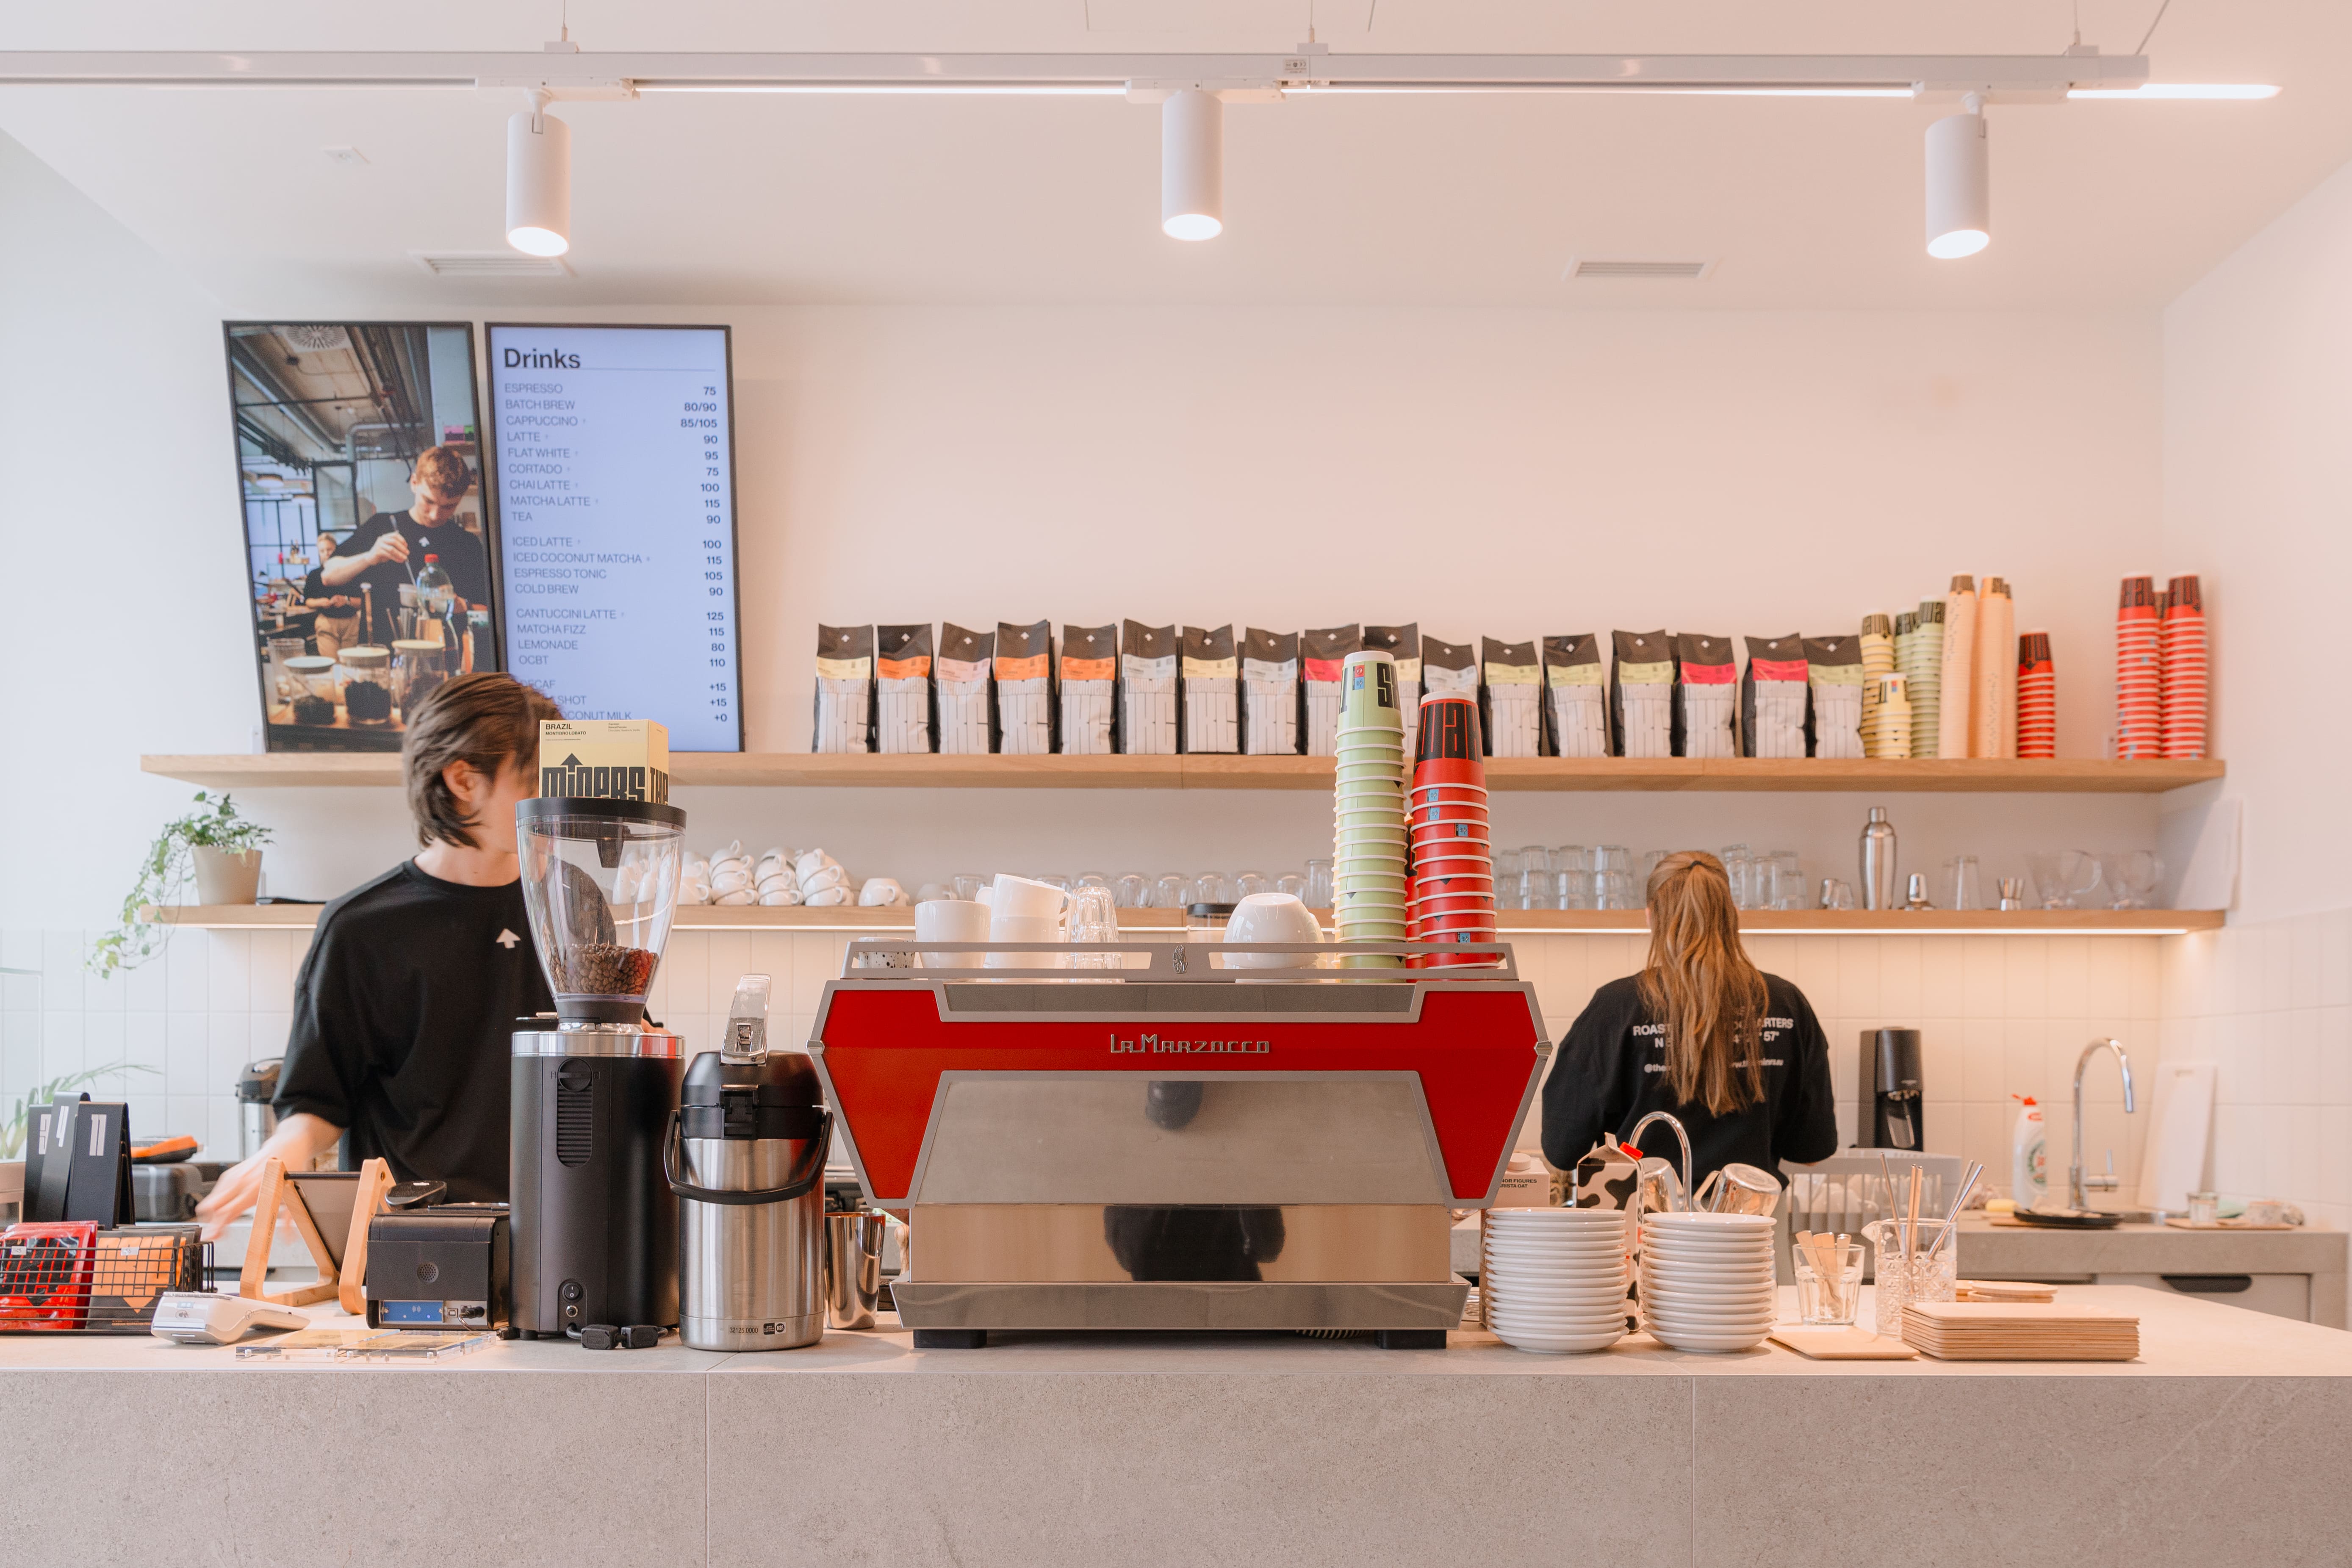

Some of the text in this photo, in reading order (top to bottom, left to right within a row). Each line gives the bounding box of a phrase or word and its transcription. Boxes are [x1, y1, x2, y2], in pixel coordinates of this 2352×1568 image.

[504, 348, 580, 368] Drinks
[504, 383, 716, 395] ESPRESSO 75
[505, 399, 717, 412] BATCH BREW 80/90
[505, 415, 578, 427] CAPPUCCINO
[681, 418, 717, 428] 85/105
[507, 431, 540, 442] LATTE
[704, 435, 718, 444] 90
[507, 447, 533, 457] FLAT
[535, 448, 570, 458] WHITE
[705, 451, 718, 460] 95
[508, 463, 562, 474] CORTADO
[706, 468, 719, 476] 75
[509, 479, 535, 490] CHAI
[537, 480, 570, 490] LATTE
[701, 484, 719, 492] 100
[510, 495, 555, 506] MATCHA
[557, 496, 590, 506] LATTE
[705, 499, 720, 508] 115
[511, 511, 720, 524] TEA 90
[512, 536, 537, 547] ICED
[539, 537, 572, 547] LATTE
[703, 540, 721, 549] 100
[513, 552, 538, 562] ICED
[540, 552, 595, 562] COCONUT
[597, 554, 642, 563] MATCHA
[707, 556, 722, 564] 115
[514, 568, 722, 580] ESPRESSO TONIC 105
[515, 583, 723, 596] COLD BREW 90
[516, 608, 582, 618] CANTUCCINI
[584, 609, 616, 619] LATTE
[707, 612, 723, 620] 125
[517, 623, 724, 636] MATCHA FIZZ 115
[518, 639, 725, 651] LEMONADE 80
[518, 655, 725, 667] OCBT 110
[557, 695, 726, 706] SHOT +15
[715, 714, 727, 722] +0
